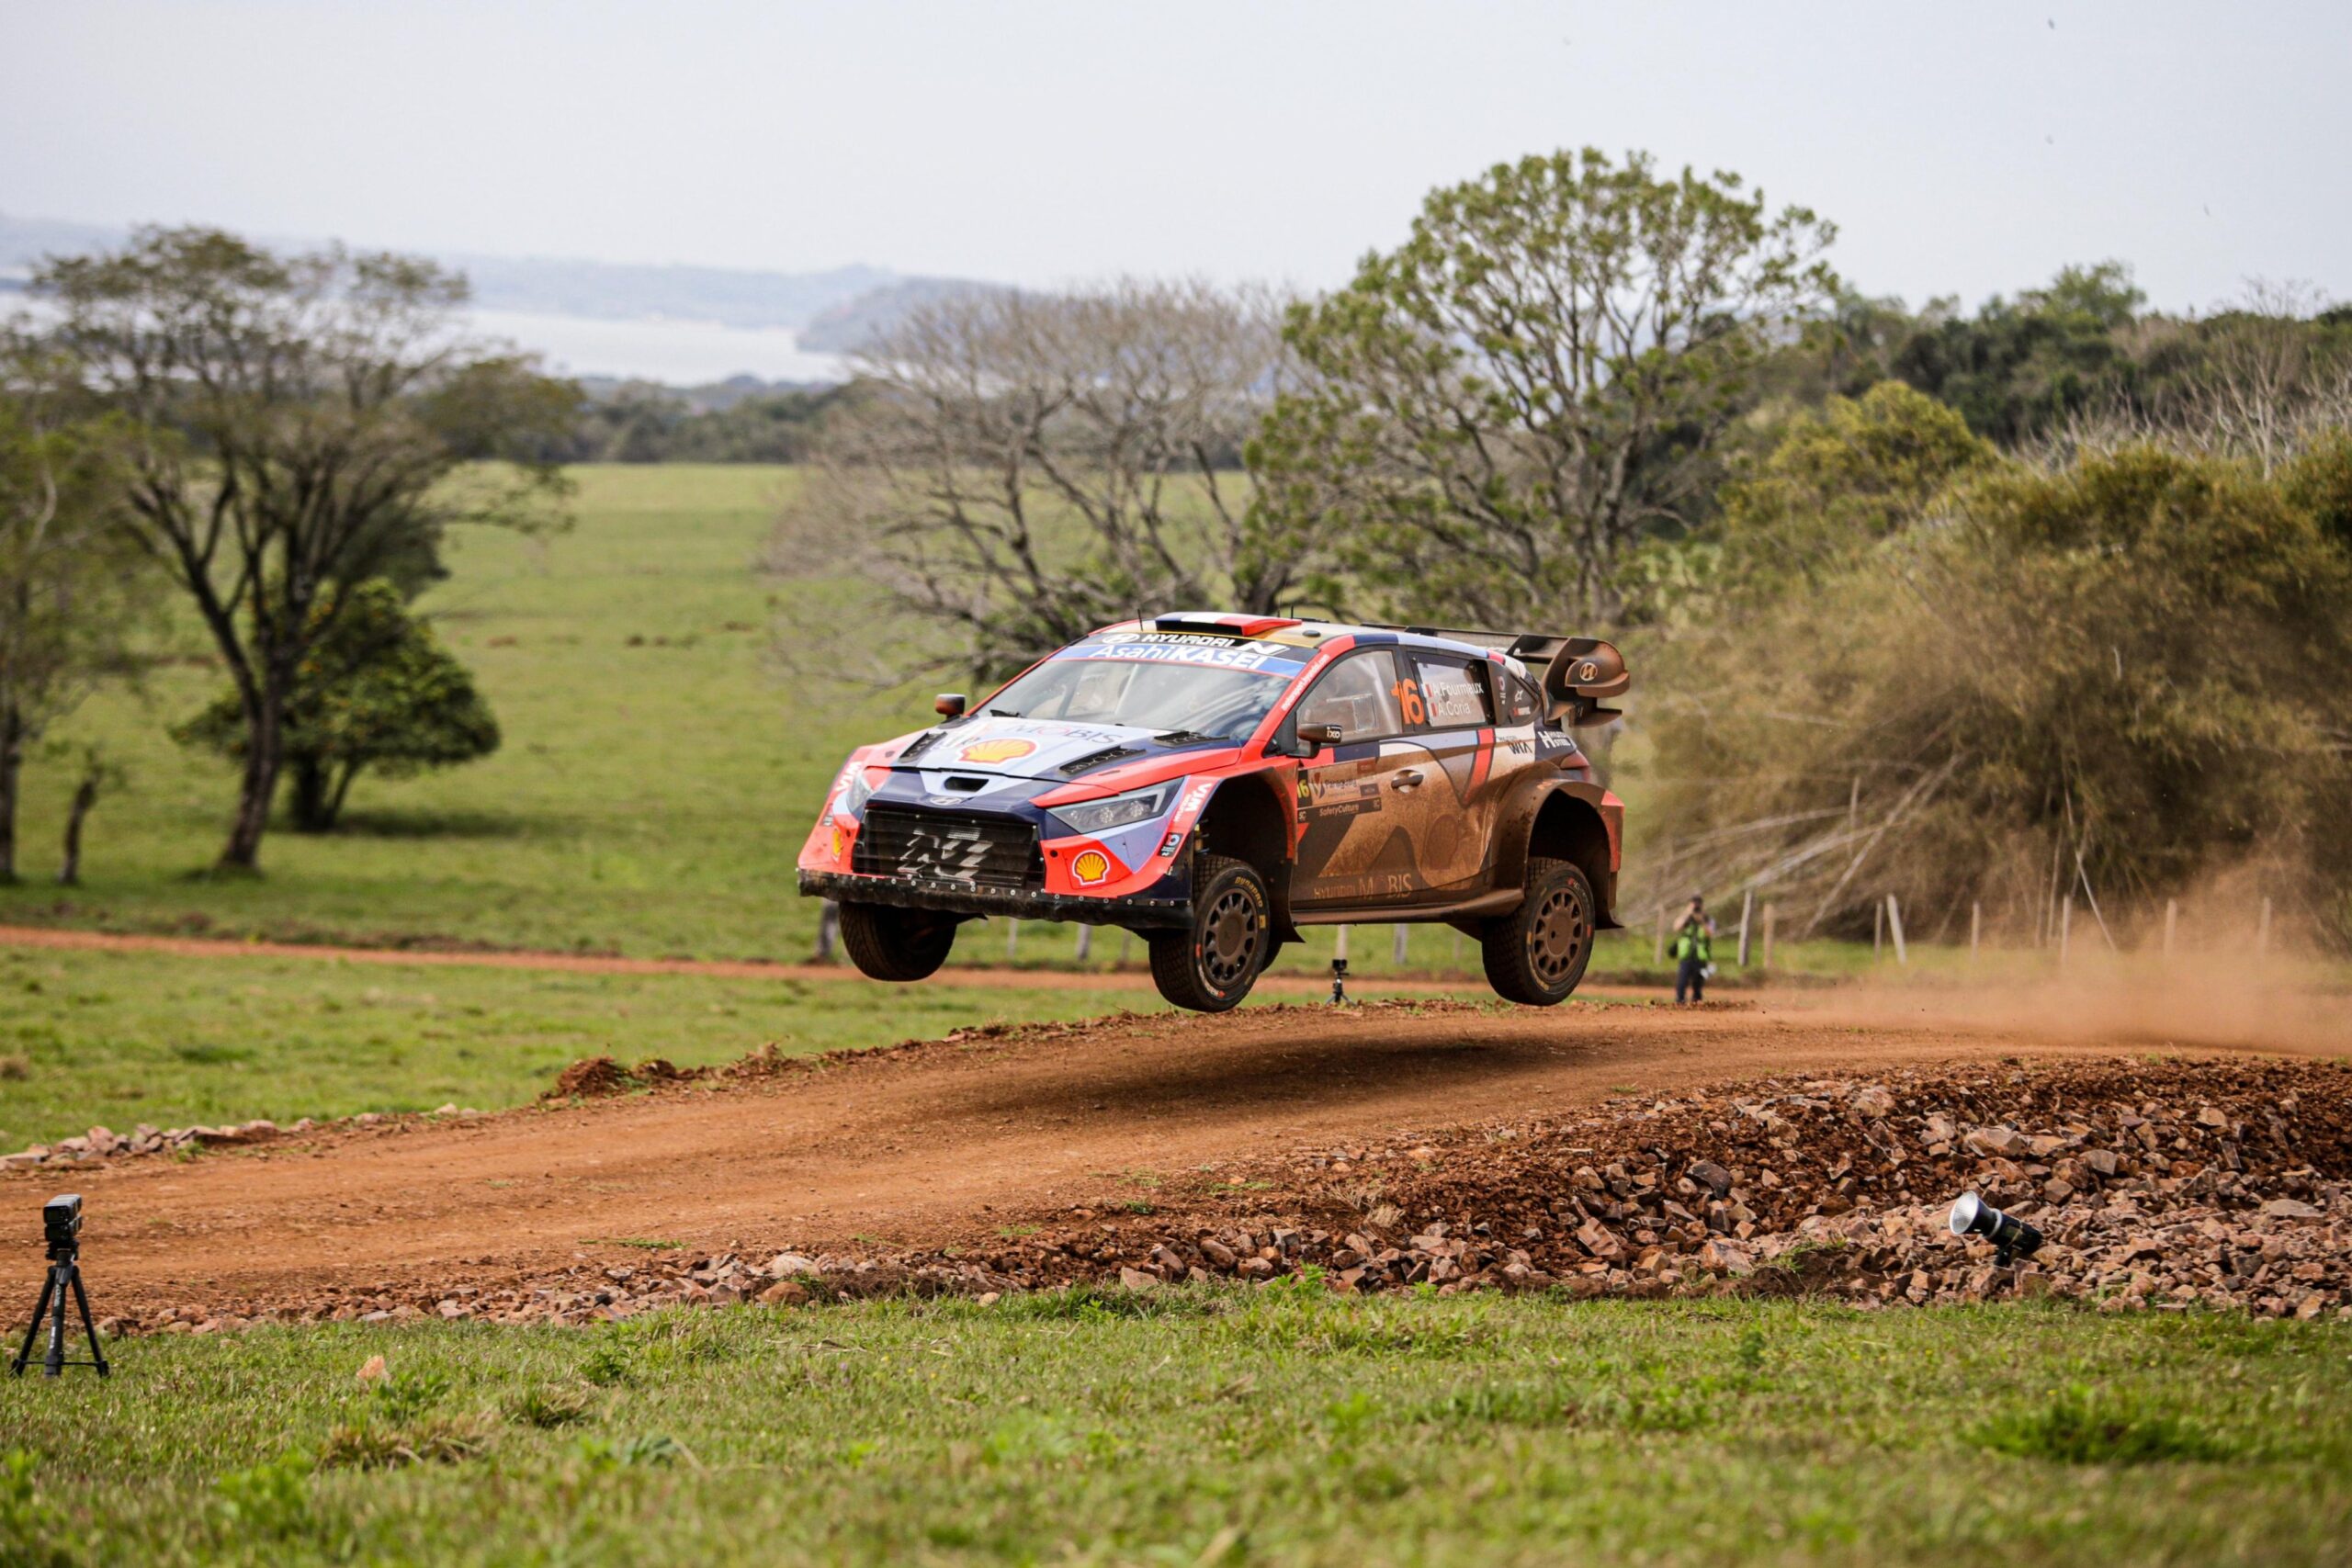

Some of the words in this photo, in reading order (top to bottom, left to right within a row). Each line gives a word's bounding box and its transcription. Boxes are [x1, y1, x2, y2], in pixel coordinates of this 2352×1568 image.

[1141, 633, 1236, 648] HYUNDAI
[1240, 641, 1290, 656] N
[1390, 678, 1425, 726] 16
